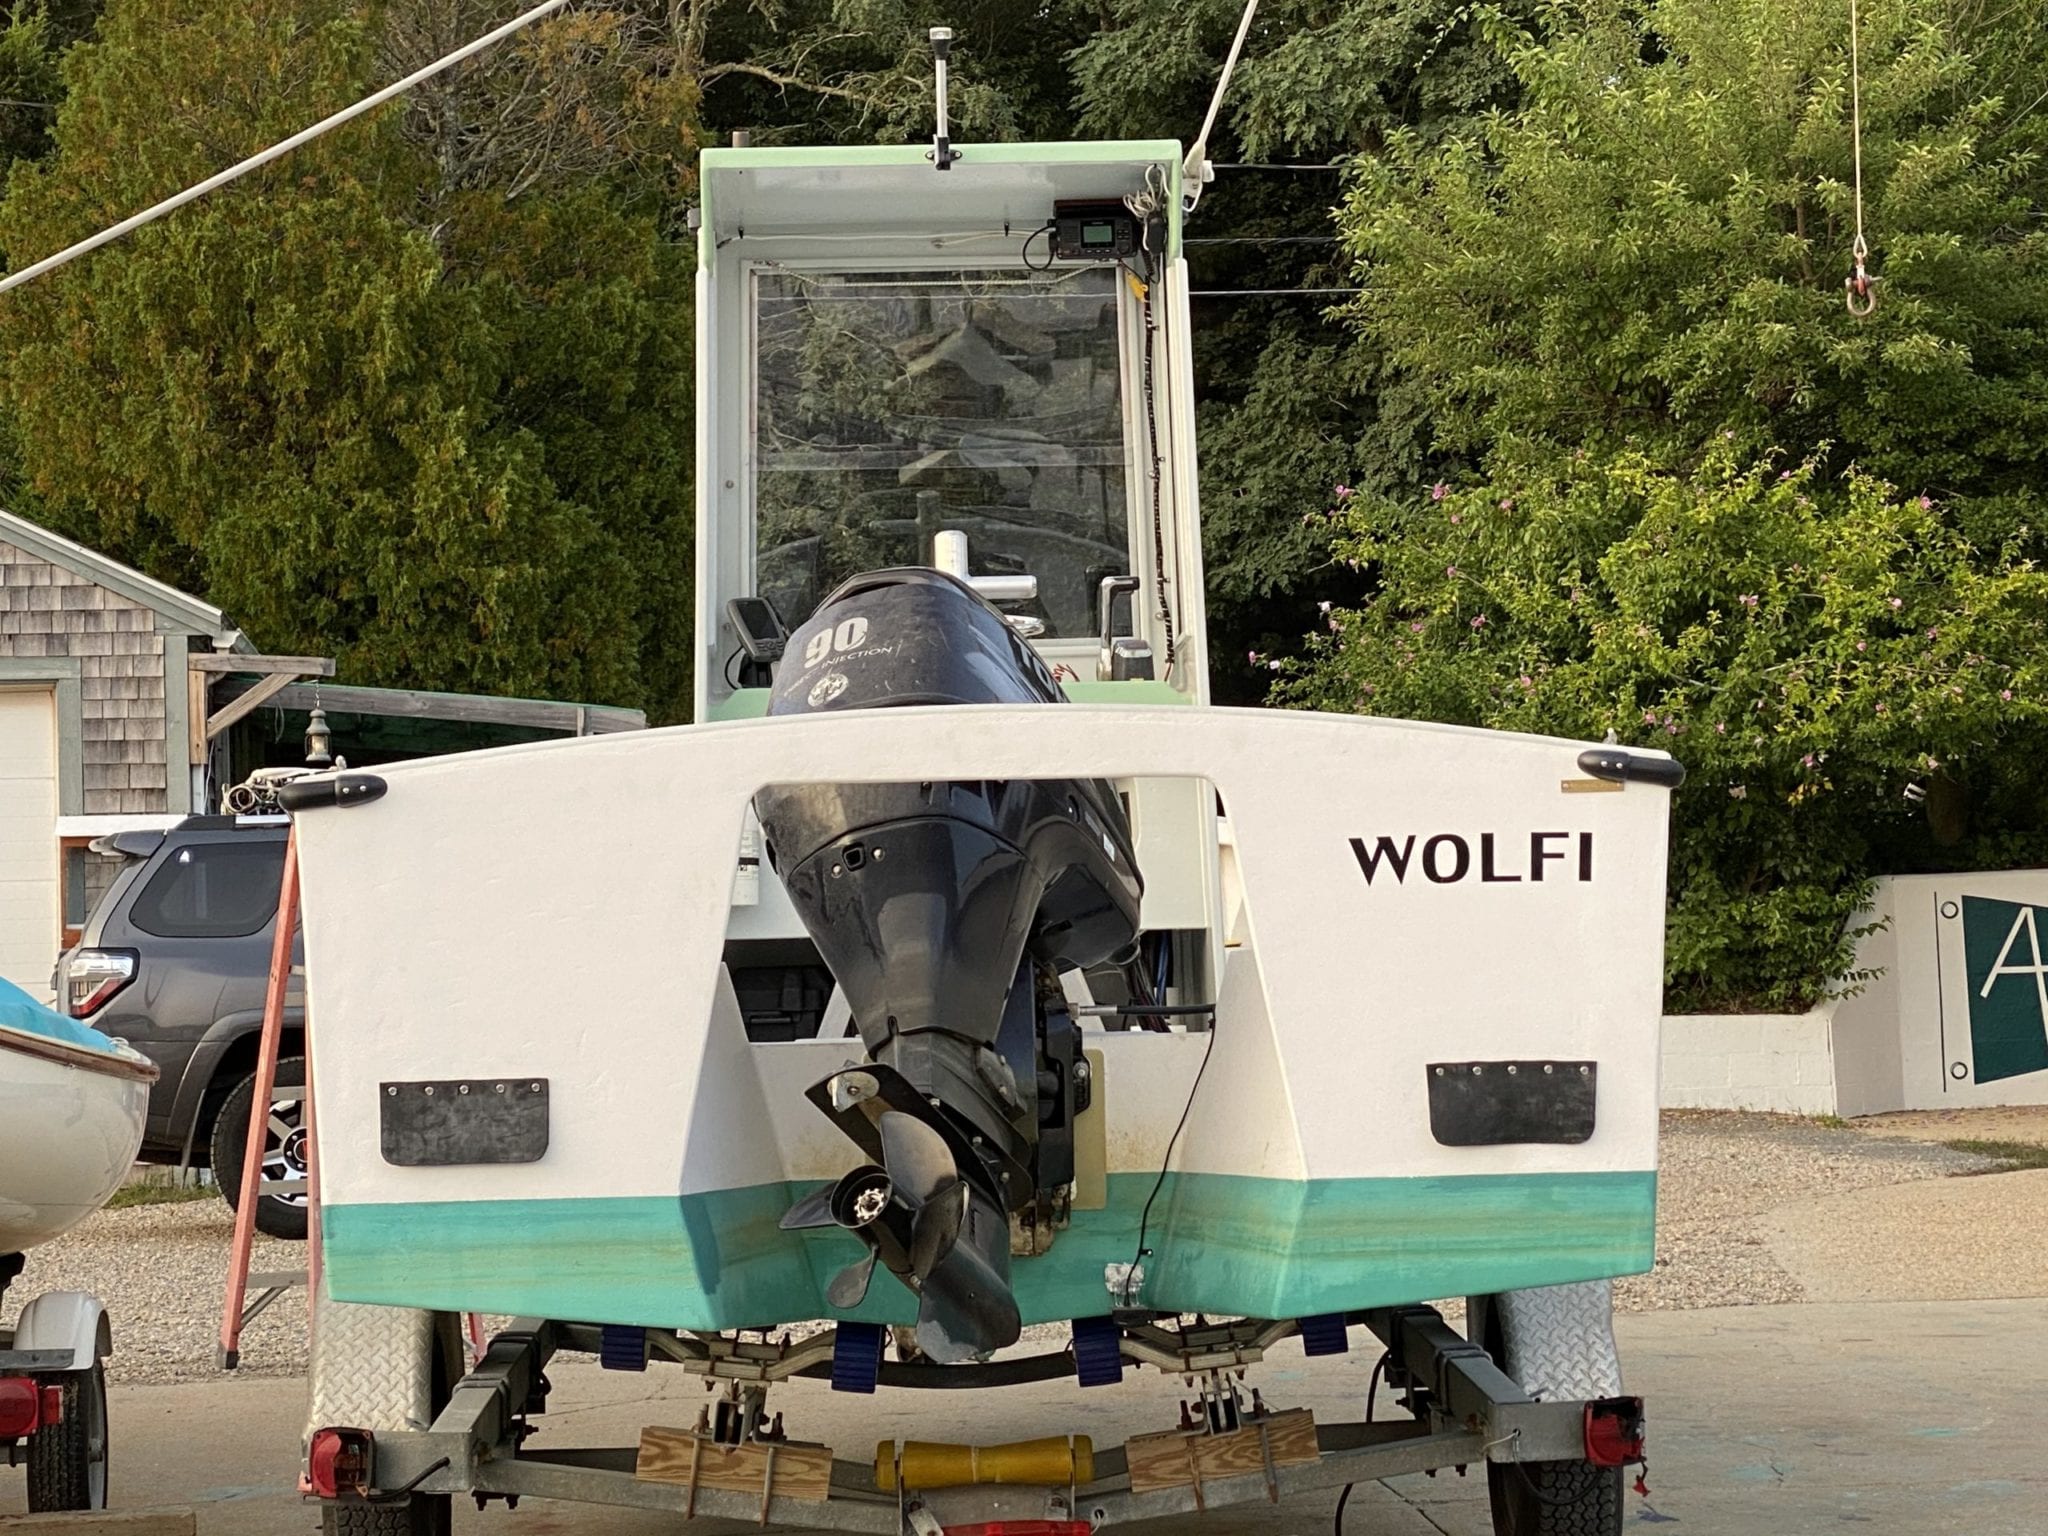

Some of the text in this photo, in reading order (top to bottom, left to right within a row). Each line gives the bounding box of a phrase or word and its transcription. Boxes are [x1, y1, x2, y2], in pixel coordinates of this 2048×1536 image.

[804, 617, 868, 669] 90
[820, 646, 893, 669] INJECTION
[1348, 831, 1593, 887] WOLFI
